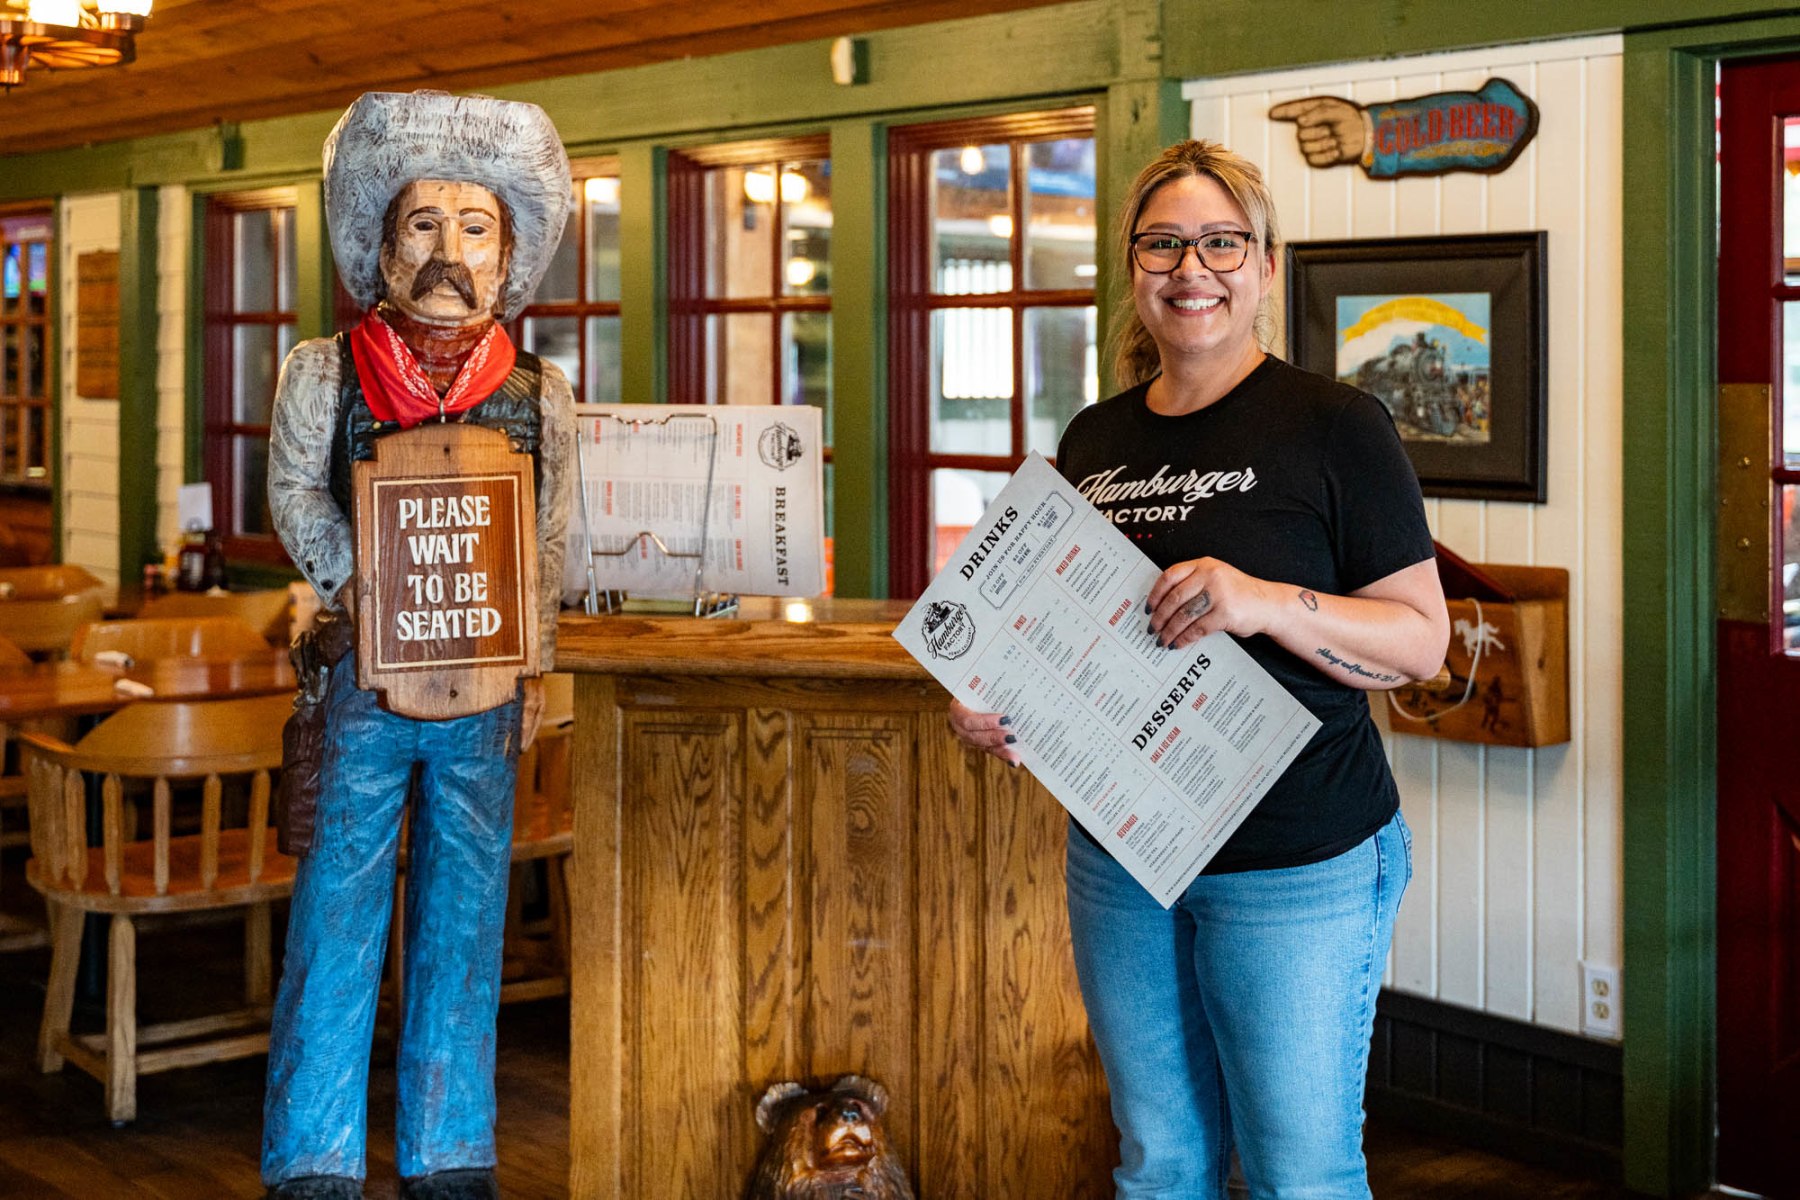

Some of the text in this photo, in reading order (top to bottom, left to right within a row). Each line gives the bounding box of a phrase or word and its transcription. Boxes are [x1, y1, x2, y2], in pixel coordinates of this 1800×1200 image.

[1378, 103, 1516, 156] COLD BEER
[1076, 464, 1258, 505] Hamburger
[399, 495, 491, 530] PLEASE
[1098, 505, 1195, 524] ACTORY
[407, 532, 480, 565] WAIT
[775, 486, 789, 587] BREAKFAST
[958, 505, 1020, 581] DRINKS
[984, 500, 1046, 580] JOIN US FOR HAPPY HOUR
[1054, 558, 1070, 576] MIXED
[1064, 543, 1081, 563] DRINKS
[407, 572, 488, 605] TO BE
[396, 607, 502, 641] SEATED
[1012, 613, 1028, 631] WINES
[1107, 597, 1132, 627] MIMOSA BAR
[927, 603, 968, 660] Hamburger
[943, 622, 966, 651] FACTORY
[967, 674, 982, 691] BEERS
[1130, 652, 1213, 751] DESSERTS
[1190, 691, 1208, 711] SHAKES
[1149, 749, 1162, 764] CAKE
[1165, 725, 1181, 743] CREAM
[1115, 812, 1139, 839] BEVERAGES
